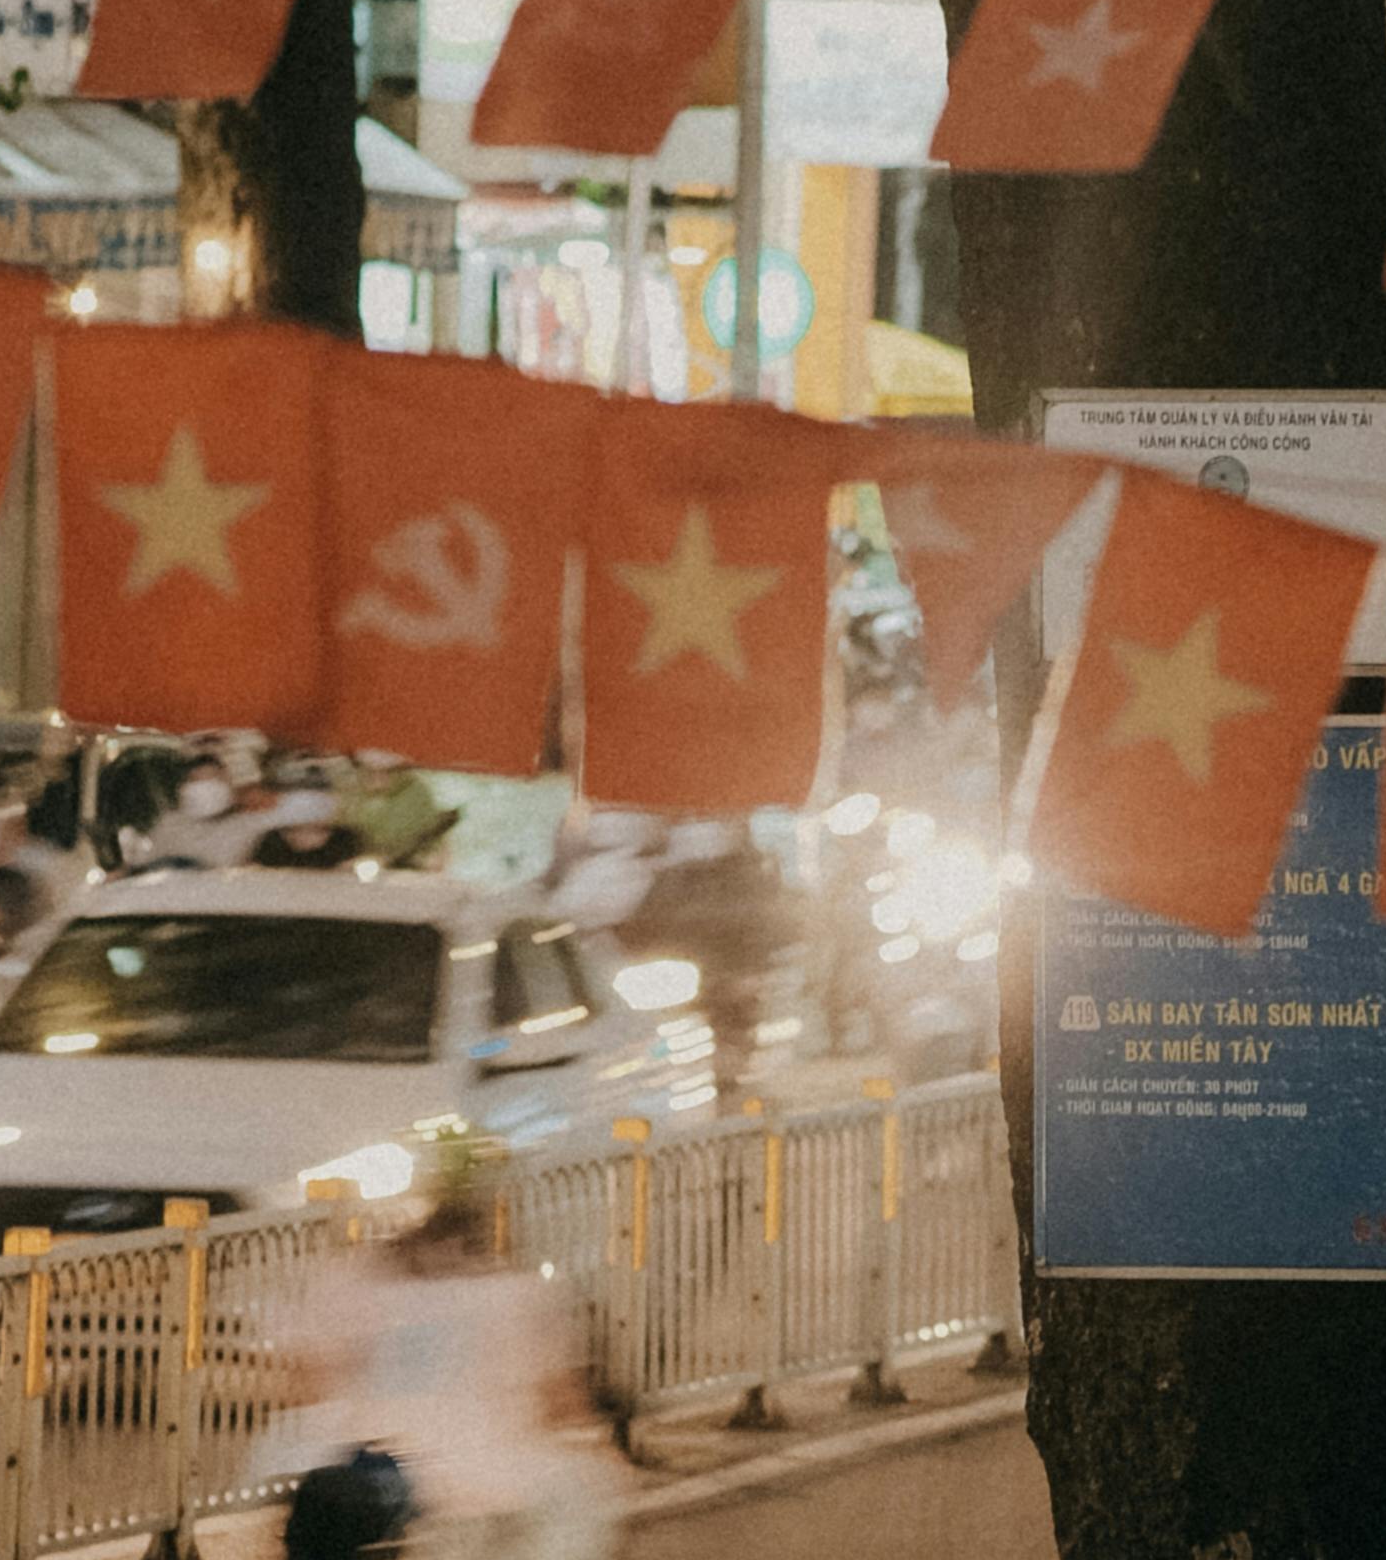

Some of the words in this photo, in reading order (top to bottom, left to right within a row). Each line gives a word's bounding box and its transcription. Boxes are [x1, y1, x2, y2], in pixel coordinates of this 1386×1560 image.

[1080, 410, 1125, 425] TRUNG
[1129, 407, 1156, 425] TÂM
[1337, 872, 1350, 895] 4
[1068, 1001, 1095, 1025] 119
[1107, 997, 1152, 1025] SÂN
[1162, 1002, 1204, 1025] BAY
[1215, 997, 1258, 1026] TÂN
[1267, 1000, 1312, 1026] SƠN
[1322, 995, 1382, 1027] NHẤT
[1124, 1040, 1153, 1062] BX
[1230, 1035, 1273, 1063] TÂY
[1101, 1100, 1132, 1115] GIAN
